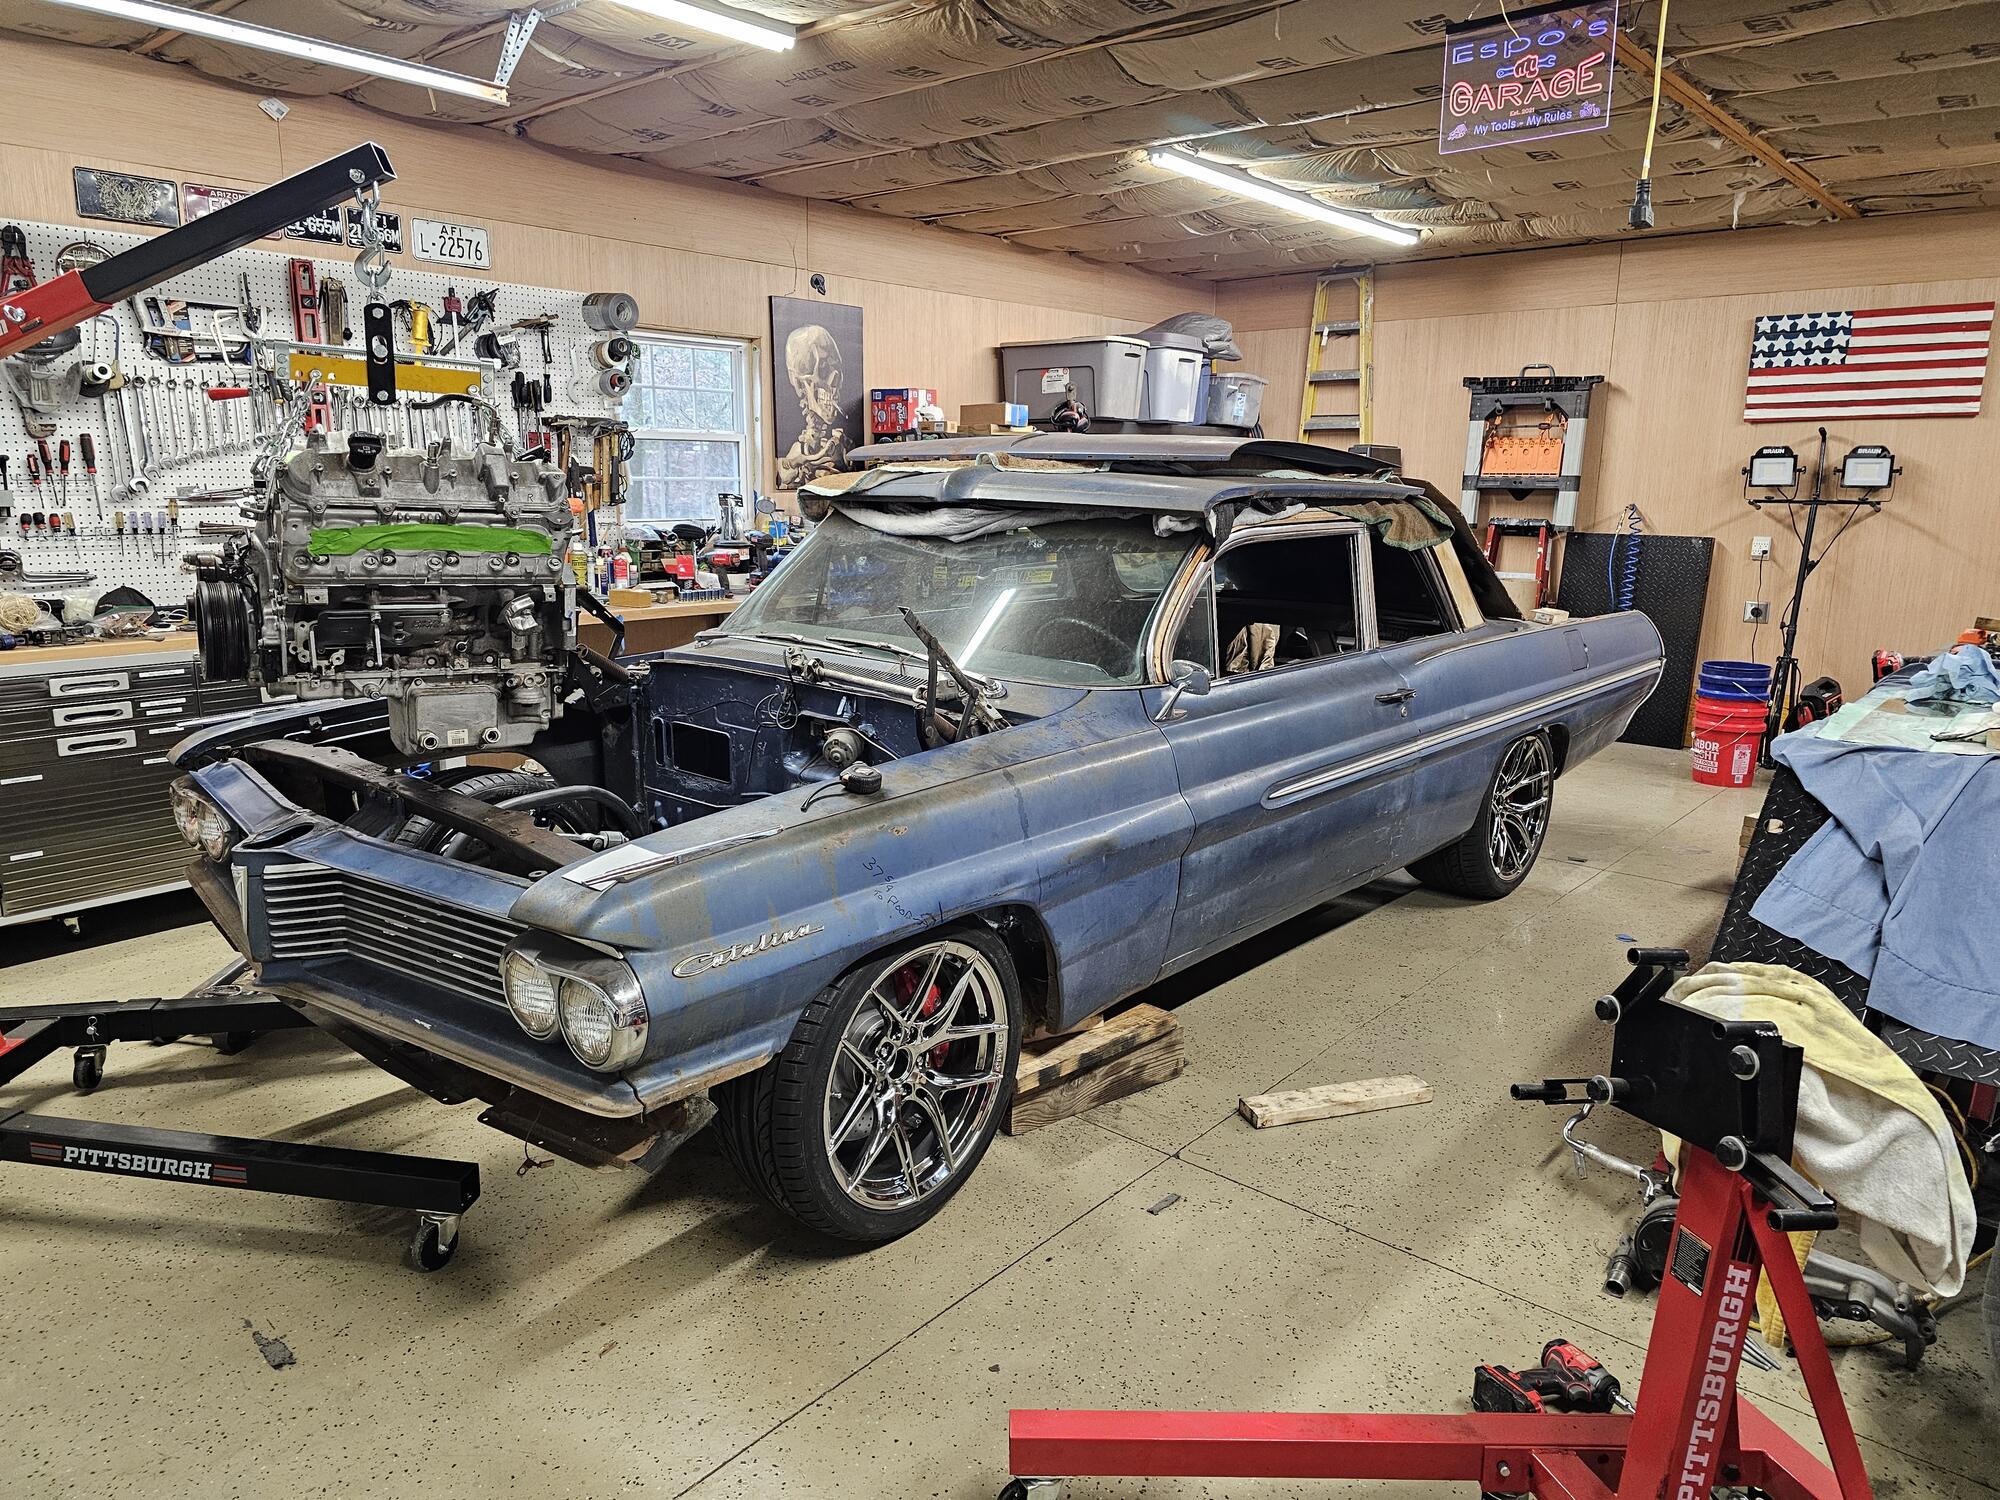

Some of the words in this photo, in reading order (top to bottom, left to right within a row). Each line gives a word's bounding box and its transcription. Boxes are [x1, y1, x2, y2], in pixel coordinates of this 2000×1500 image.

[650, 33, 697, 49] JM
[1450, 52, 1605, 117] GARAGE
[1474, 123, 1488, 136] My
[1490, 119, 1517, 132] Tools
[1526, 116, 1541, 128] My
[1544, 110, 1573, 123] Rules
[210, 190, 252, 200] ARIZON
[440, 224, 463, 237] AFI
[418, 232, 483, 261] L-22576
[862, 857, 884, 877] 37
[672, 923, 825, 978] Catalina
[63, 1145, 212, 1180] PITTSBURGH
[1676, 1264, 1752, 1500] PITTSBURGH
